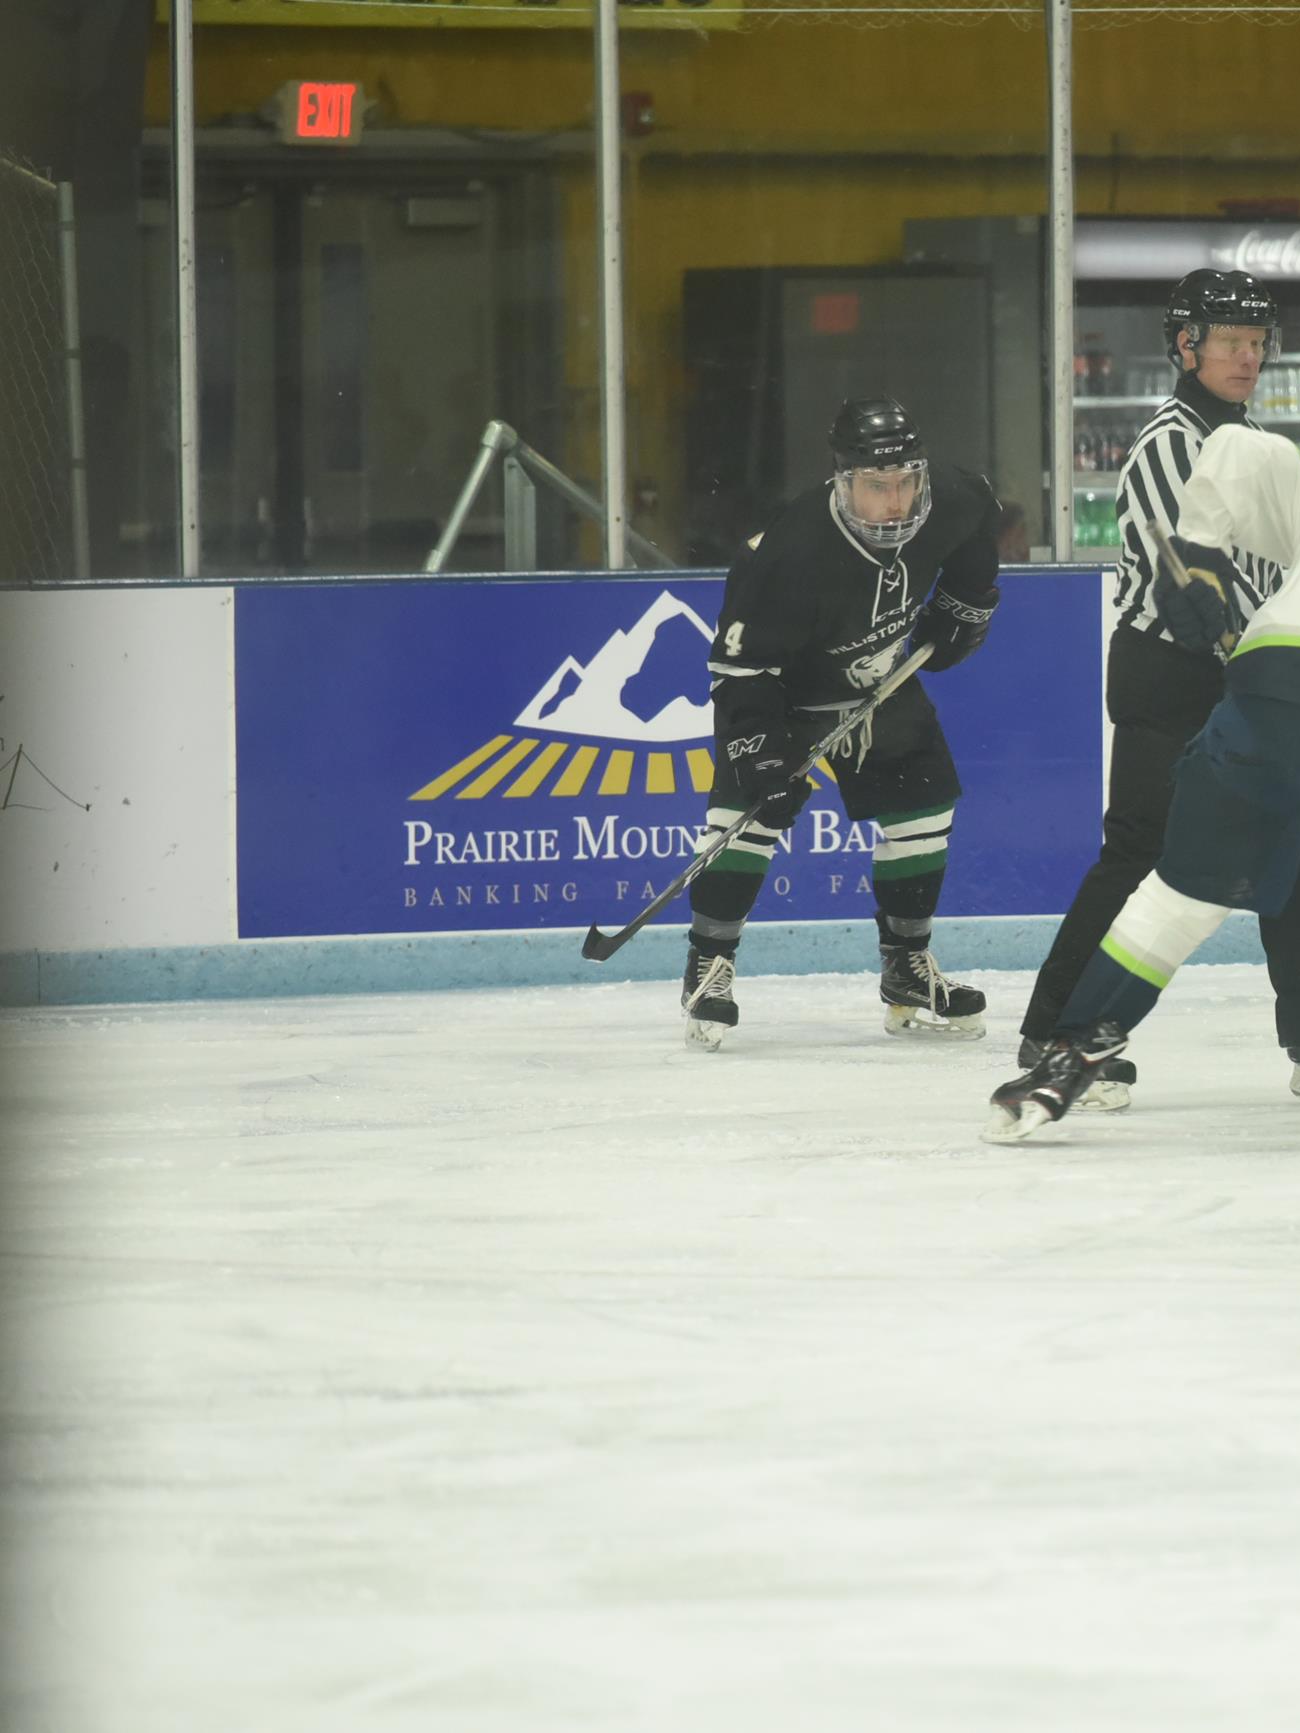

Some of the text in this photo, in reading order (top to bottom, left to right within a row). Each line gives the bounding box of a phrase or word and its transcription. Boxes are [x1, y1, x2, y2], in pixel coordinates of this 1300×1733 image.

[298, 83, 356, 137] EXIT
[1240, 300, 1269, 308] CCM
[873, 445, 903, 455] CCM
[724, 620, 745, 656] 4
[826, 617, 907, 656] WILLISTON
[403, 820, 561, 866] PRAIRIE
[809, 810, 887, 853] BAN
[404, 881, 578, 907] BANKING
